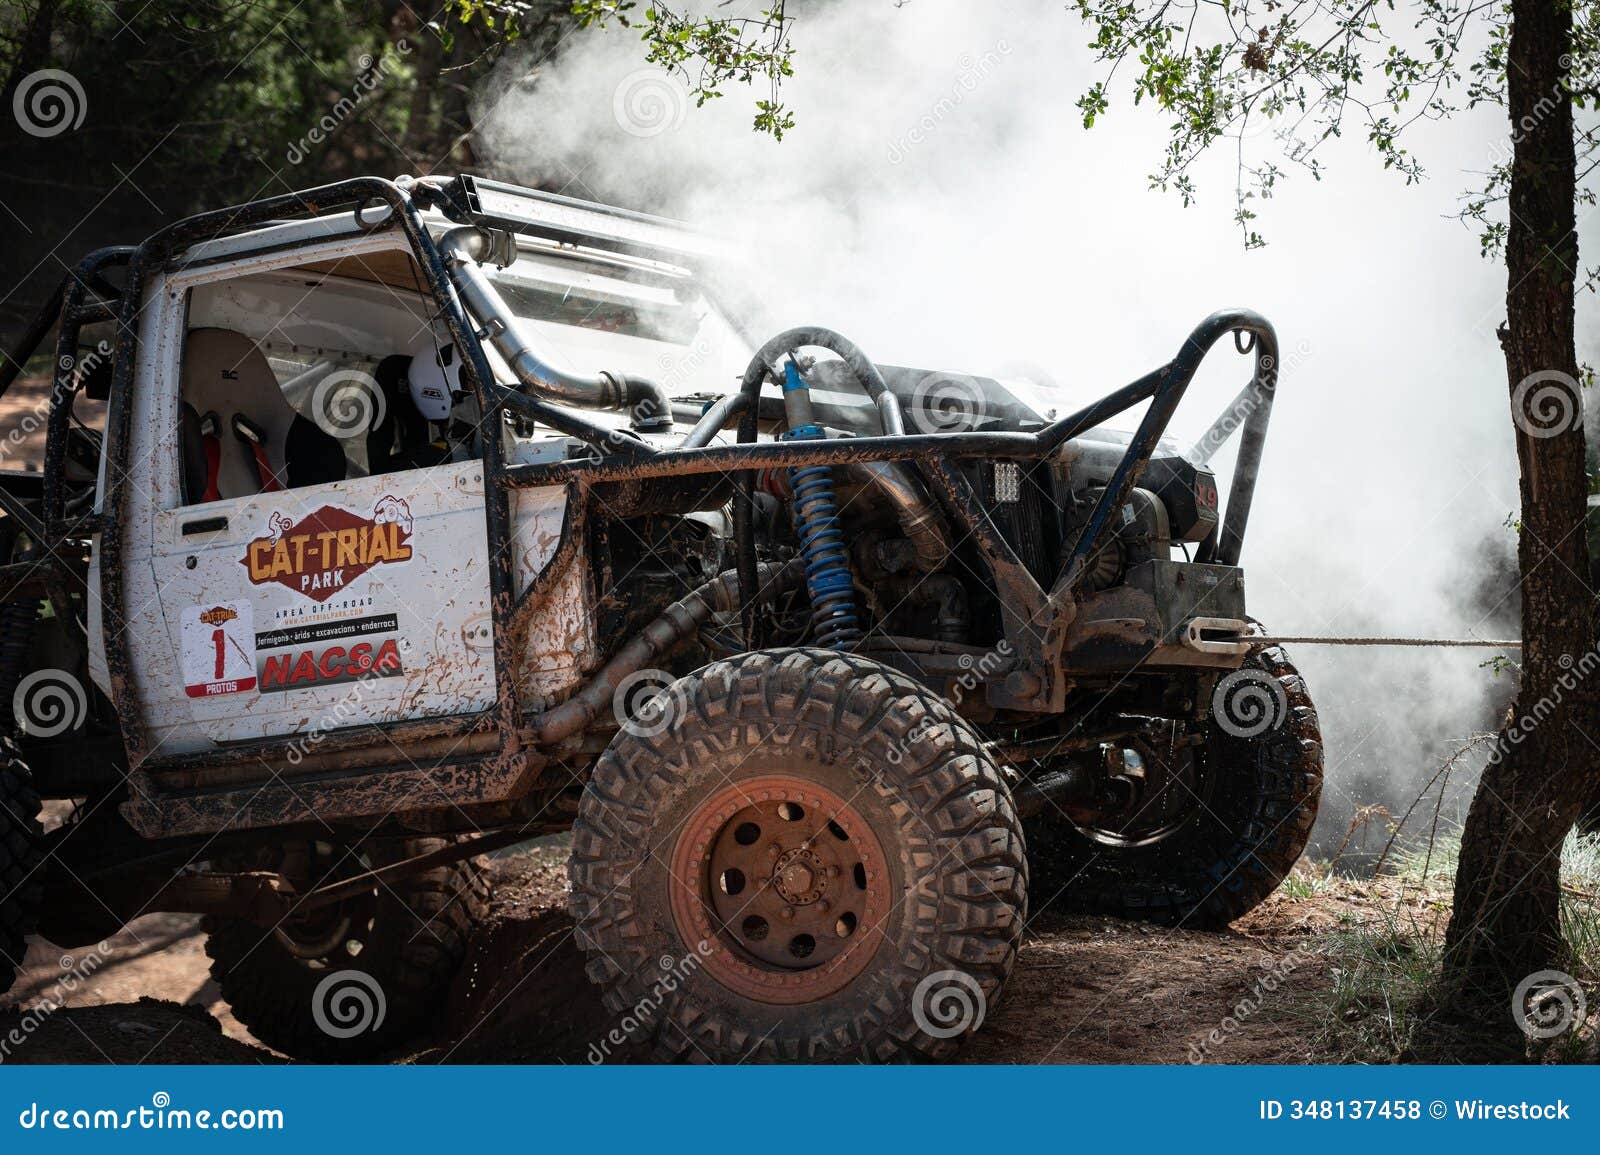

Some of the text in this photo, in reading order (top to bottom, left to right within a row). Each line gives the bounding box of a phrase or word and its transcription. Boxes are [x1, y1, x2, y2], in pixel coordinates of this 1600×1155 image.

[250, 521, 411, 581] CAT-TRIAL
[301, 569, 344, 591] PARK
[312, 597, 373, 614] OFF-ROAD
[316, 625, 356, 637] excavacions
[361, 619, 396, 631] enderrocs
[211, 629, 225, 679] 1
[261, 639, 400, 687] NACSA
[206, 681, 238, 694] PROTOS
